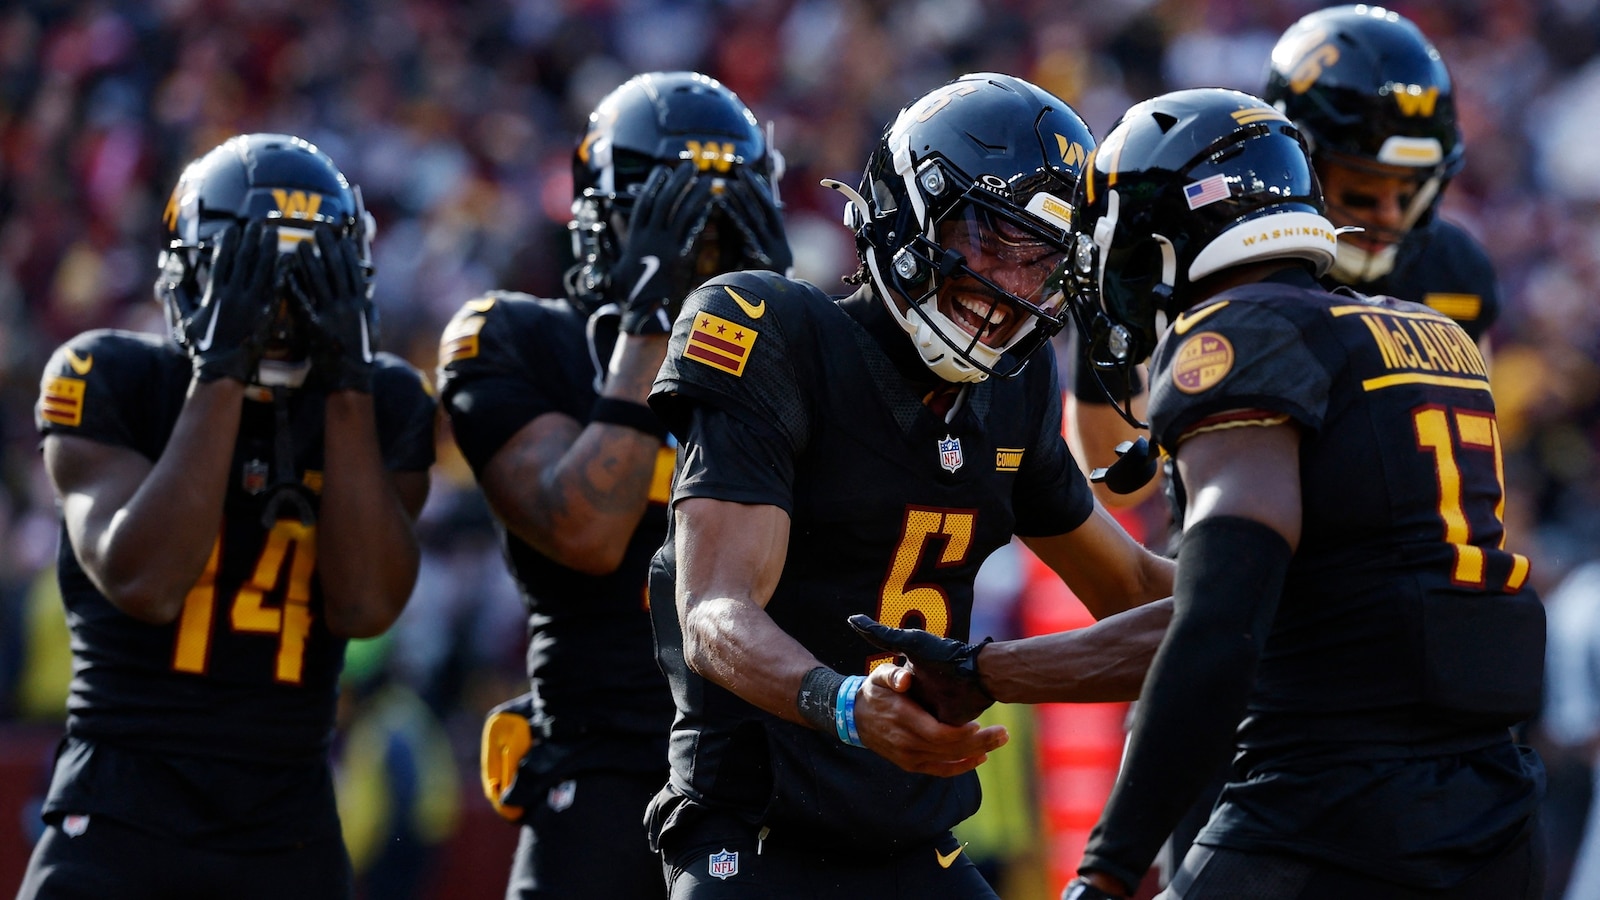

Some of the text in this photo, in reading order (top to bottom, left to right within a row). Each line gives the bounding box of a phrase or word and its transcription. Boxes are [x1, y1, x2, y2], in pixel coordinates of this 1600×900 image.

[974, 180, 1011, 198] OAKLEY
[272, 188, 322, 221] W
[943, 451, 960, 466] NFL
[1411, 403, 1532, 595] 17
[171, 515, 318, 688] 14
[714, 862, 734, 874] NFL
